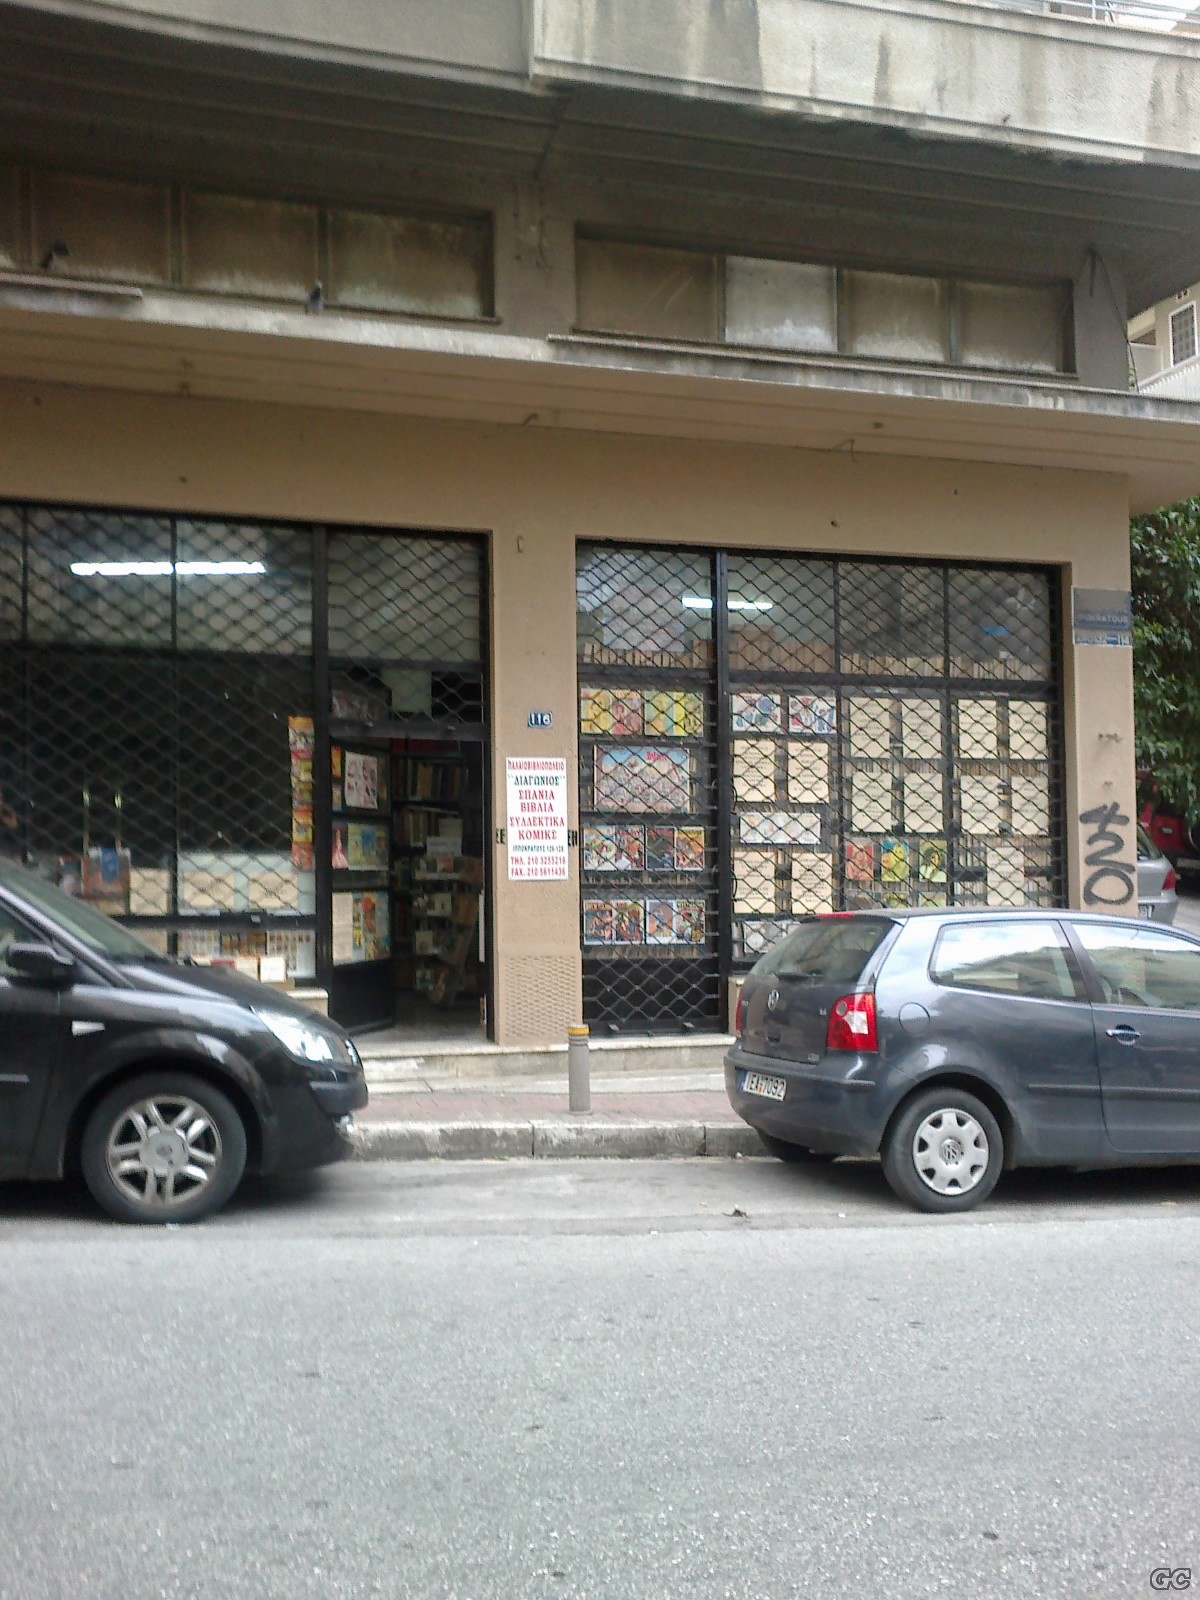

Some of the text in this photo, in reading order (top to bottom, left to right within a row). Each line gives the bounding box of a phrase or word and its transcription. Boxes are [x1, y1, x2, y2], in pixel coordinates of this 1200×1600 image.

[530, 712, 551, 726] 116
[518, 790, 555, 800] ΣΠΑΝΙΑ
[520, 802, 554, 812] ΒΙΒΛΙΑ
[509, 816, 565, 827] ΣΥΛΛΕΚΤΙΚΑ
[518, 829, 557, 840] ΚΟΜΙΚΣ
[1079, 801, 1136, 906] 420
